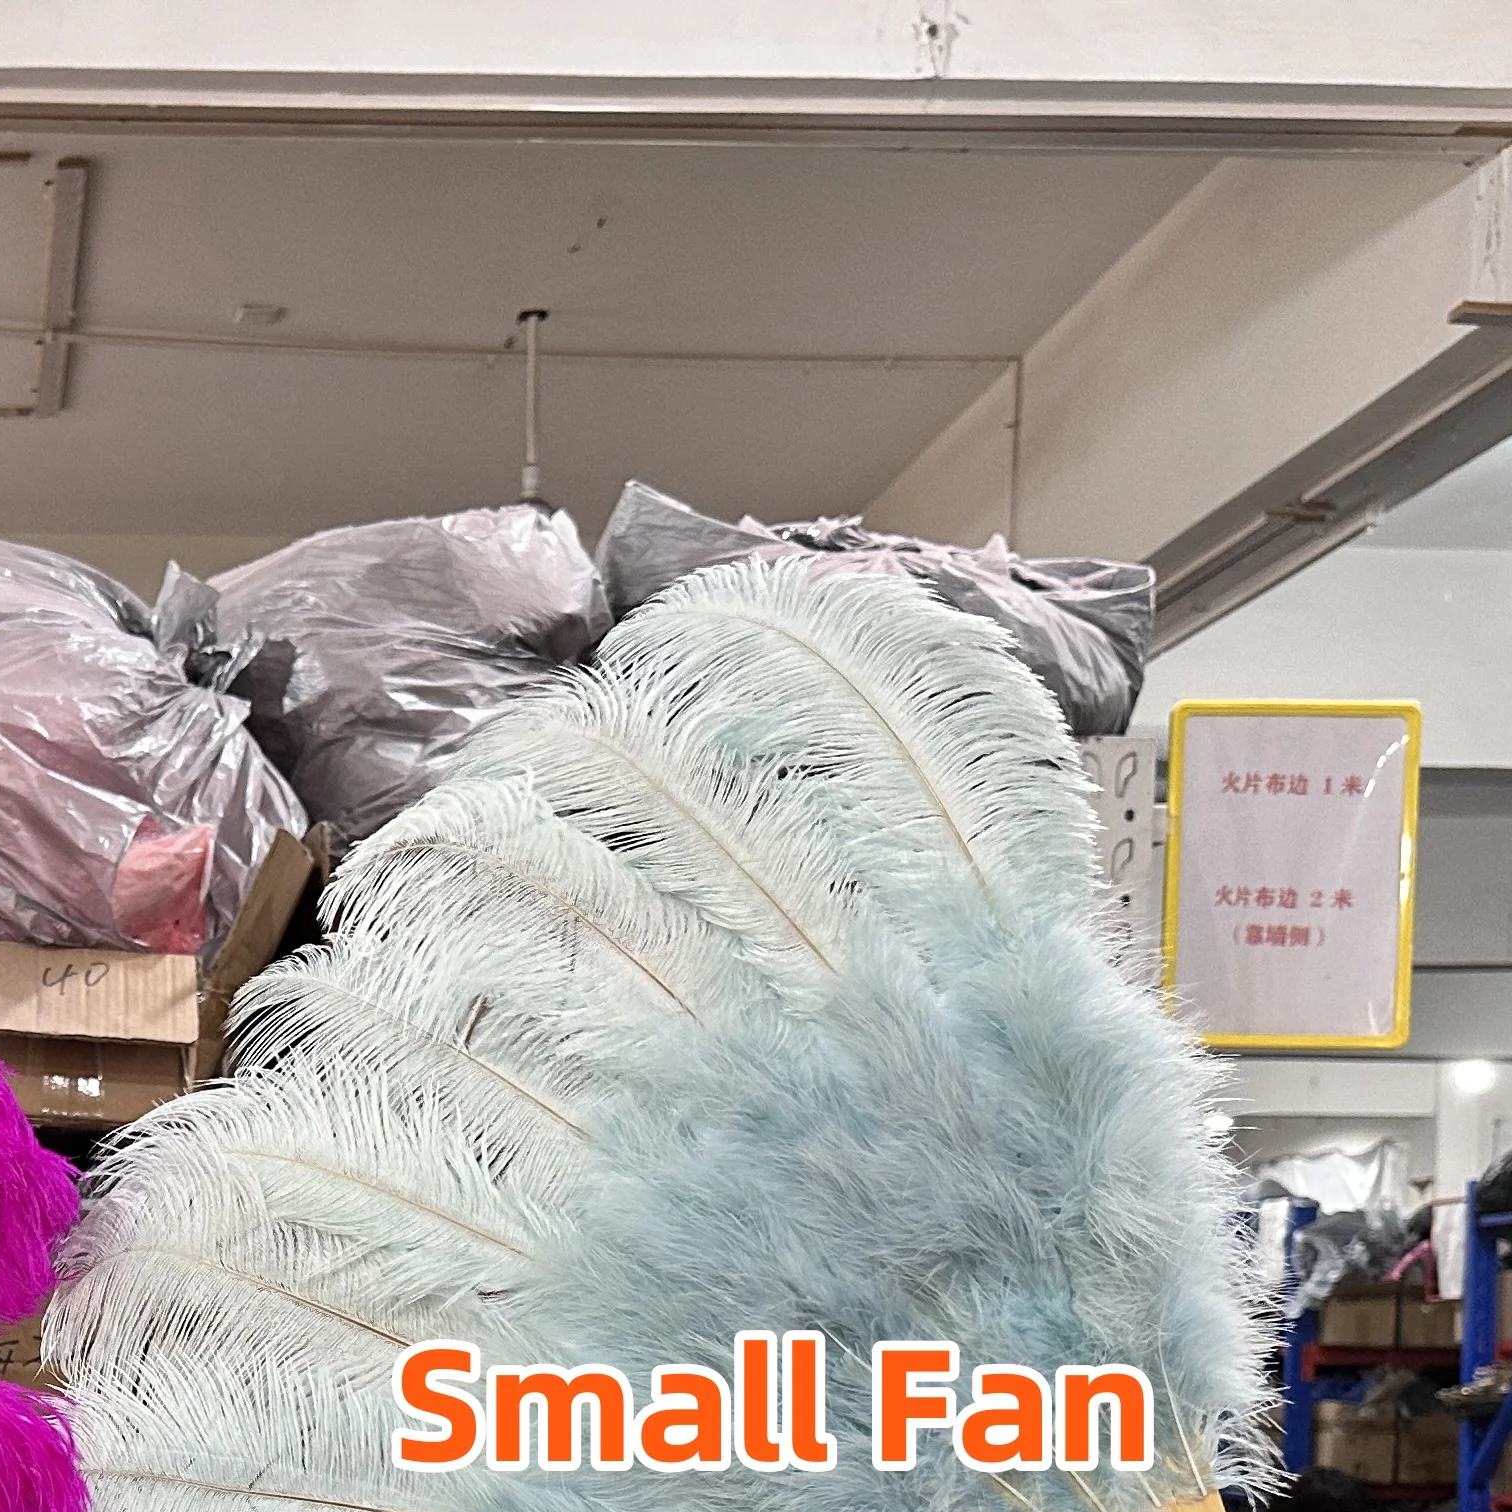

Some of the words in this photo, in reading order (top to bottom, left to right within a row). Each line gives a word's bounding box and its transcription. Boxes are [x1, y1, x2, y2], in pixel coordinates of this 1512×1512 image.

[1322, 775, 1333, 795] 1
[1340, 772, 1364, 796] 米
[1309, 888, 1323, 907] 2
[1330, 888, 1354, 910] 米
[41, 960, 110, 995] 40
